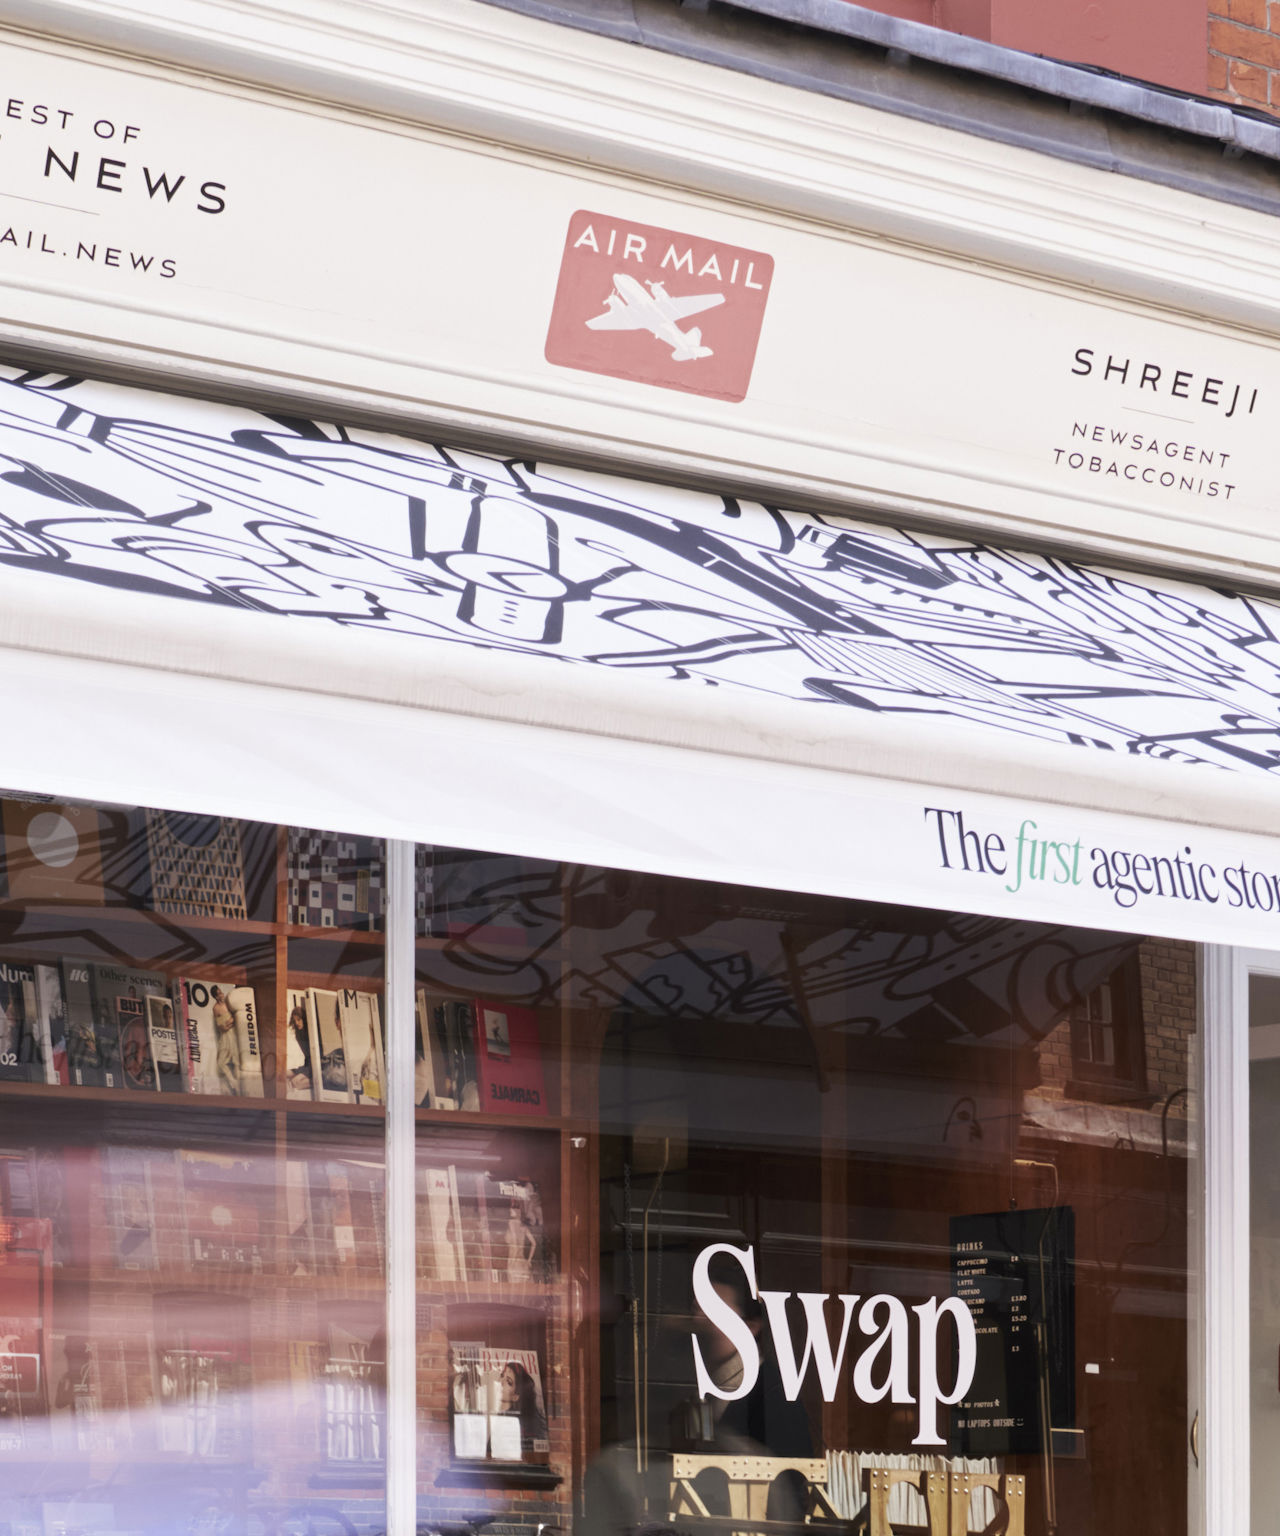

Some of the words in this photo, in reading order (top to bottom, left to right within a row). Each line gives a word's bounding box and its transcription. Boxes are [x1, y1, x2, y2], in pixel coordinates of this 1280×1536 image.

[93, 119, 141, 144] OF
[43, 145, 227, 214] NEWS
[573, 223, 647, 263] AIR
[660, 243, 764, 291] MAIL
[1070, 347, 1259, 418] SHREEJI
[1052, 448, 1236, 500] TOBACCONIST
[1072, 421, 1232, 469] NEWSAGENT
[924, 807, 1007, 876] The
[1005, 820, 1085, 893] first
[1090, 846, 1220, 908] agentic
[245, 1003, 259, 1056] FREEDOM
[691, 1243, 978, 1445] Swap
